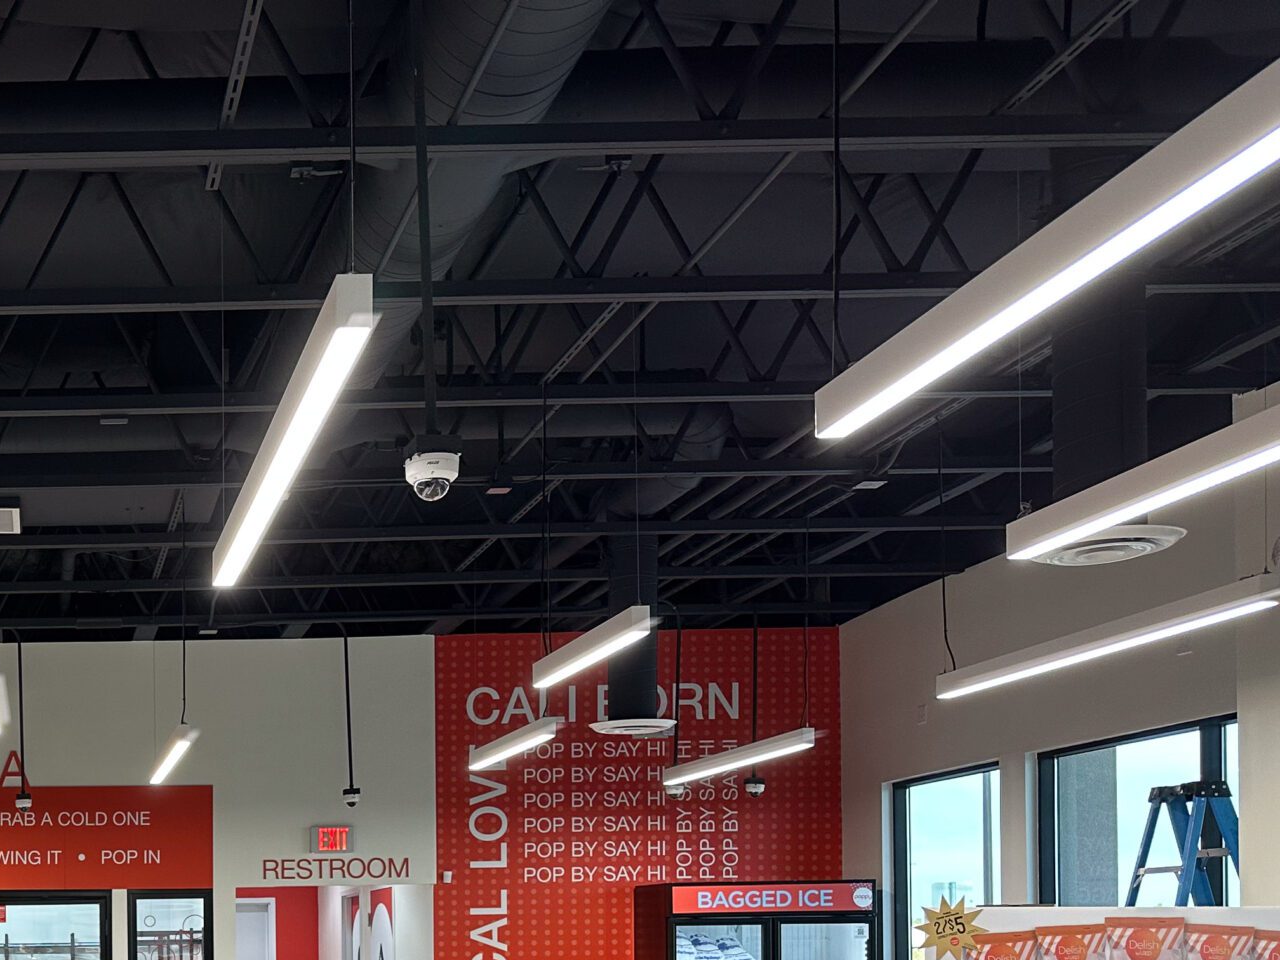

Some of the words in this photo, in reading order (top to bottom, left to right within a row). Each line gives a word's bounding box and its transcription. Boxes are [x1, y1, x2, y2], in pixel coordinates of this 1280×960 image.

[466, 685, 576, 725] CALI
[598, 682, 739, 722] RN
[572, 742, 597, 759] BY
[603, 741, 641, 757] SAY
[648, 741, 666, 757] HI
[524, 768, 564, 784] POP
[572, 767, 597, 783] BY
[603, 766, 641, 782] SAY
[699, 774, 715, 800] SA
[524, 793, 564, 809] POP
[572, 792, 597, 808] BY
[603, 791, 641, 807] SAY
[648, 791, 666, 807] HI
[41, 812, 53, 826] A
[58, 811, 108, 826] COLD
[113, 811, 150, 826] ONE
[524, 818, 564, 834] POP
[572, 817, 597, 833] BY
[603, 816, 641, 832] SAY
[648, 816, 666, 832] HI
[676, 807, 692, 832] BY
[700, 807, 715, 832] BY
[723, 806, 738, 832] BY
[318, 828, 349, 850] EXIT
[47, 850, 62, 865] IT
[101, 850, 137, 865] POP
[144, 850, 161, 864] IN
[524, 843, 564, 859] POP
[572, 842, 597, 858] BY
[603, 841, 641, 857] SAY
[648, 841, 666, 857] HI
[676, 839, 692, 878] POP
[700, 839, 715, 878] POP
[723, 839, 738, 878] POP
[262, 857, 409, 880] RESTROOM
[524, 867, 564, 883] POP
[572, 867, 597, 883] BY
[603, 865, 641, 881] SAY
[648, 865, 666, 881] HI
[698, 890, 792, 909] BAGGED
[798, 890, 833, 907] ICE
[934, 916, 966, 934] 2/$5
[1129, 939, 1159, 950] Delish
